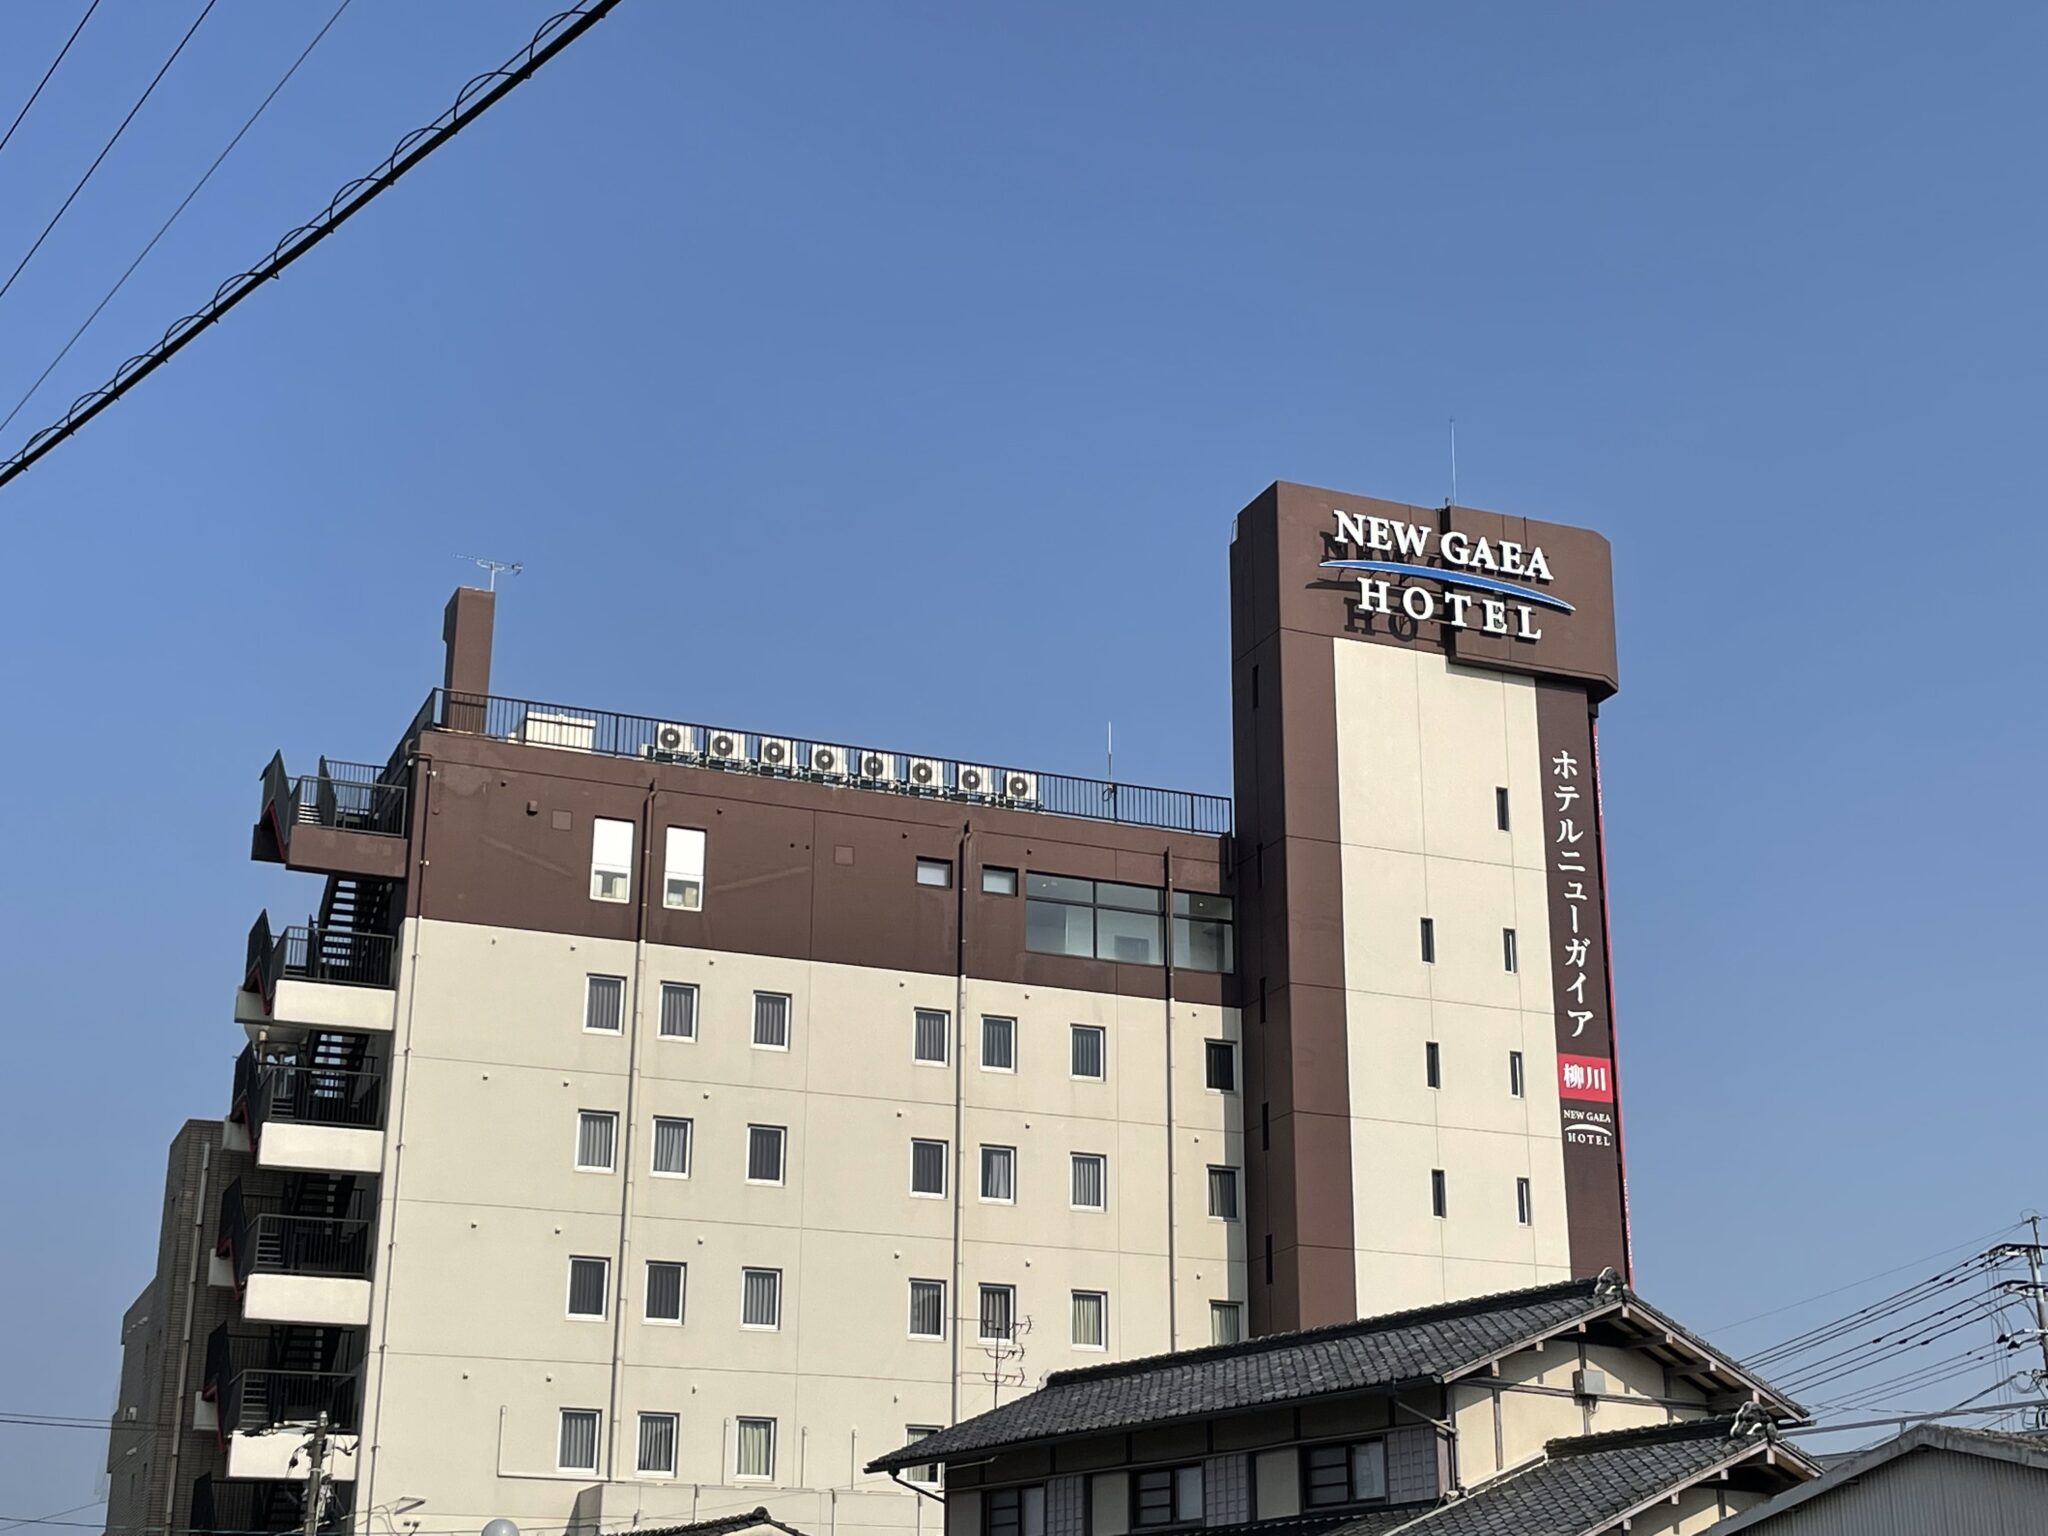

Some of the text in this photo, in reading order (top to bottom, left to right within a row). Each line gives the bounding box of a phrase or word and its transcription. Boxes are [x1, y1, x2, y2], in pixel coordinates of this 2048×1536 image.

[1333, 509, 1554, 580] NEW GAEA
[1357, 577, 1542, 639] HOTEL
[1552, 750, 1594, 1037] ホテルニューガイア
[1563, 1063, 1606, 1091] 柳川
[1563, 1109, 1611, 1123] NEW GAEA
[1567, 1132, 1611, 1146] HOTEL
